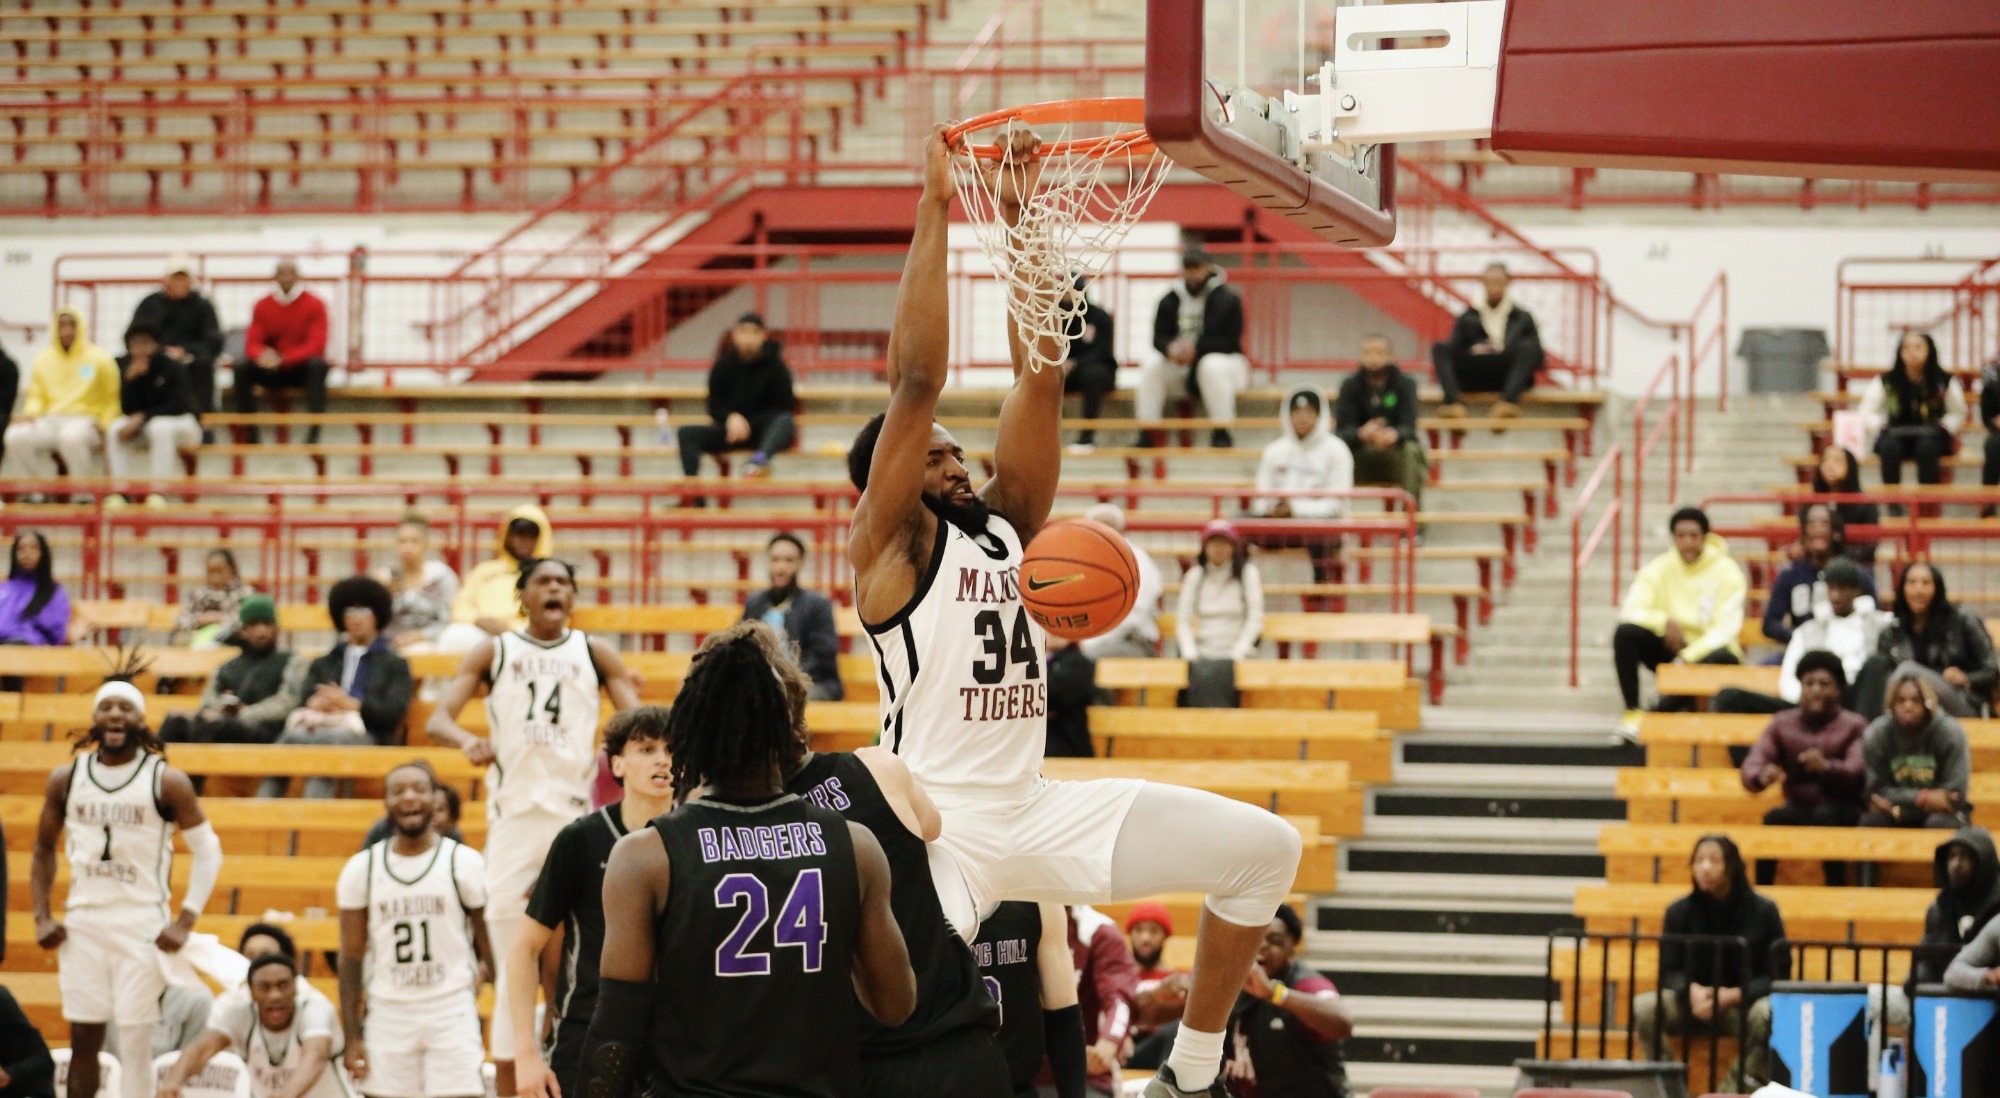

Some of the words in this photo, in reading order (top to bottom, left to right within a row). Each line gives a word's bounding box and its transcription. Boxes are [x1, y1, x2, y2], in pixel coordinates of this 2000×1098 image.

[972, 605, 1040, 685] 34
[526, 680, 561, 724] 14
[960, 683, 1045, 721] TIGERS
[76, 802, 145, 825] MAROON
[101, 821, 112, 861] 1
[698, 822, 827, 863] BADGERS
[379, 895, 445, 920] MAROON
[714, 868, 828, 977] 24
[394, 920, 431, 964] 21
[997, 938, 1028, 966] HILL
